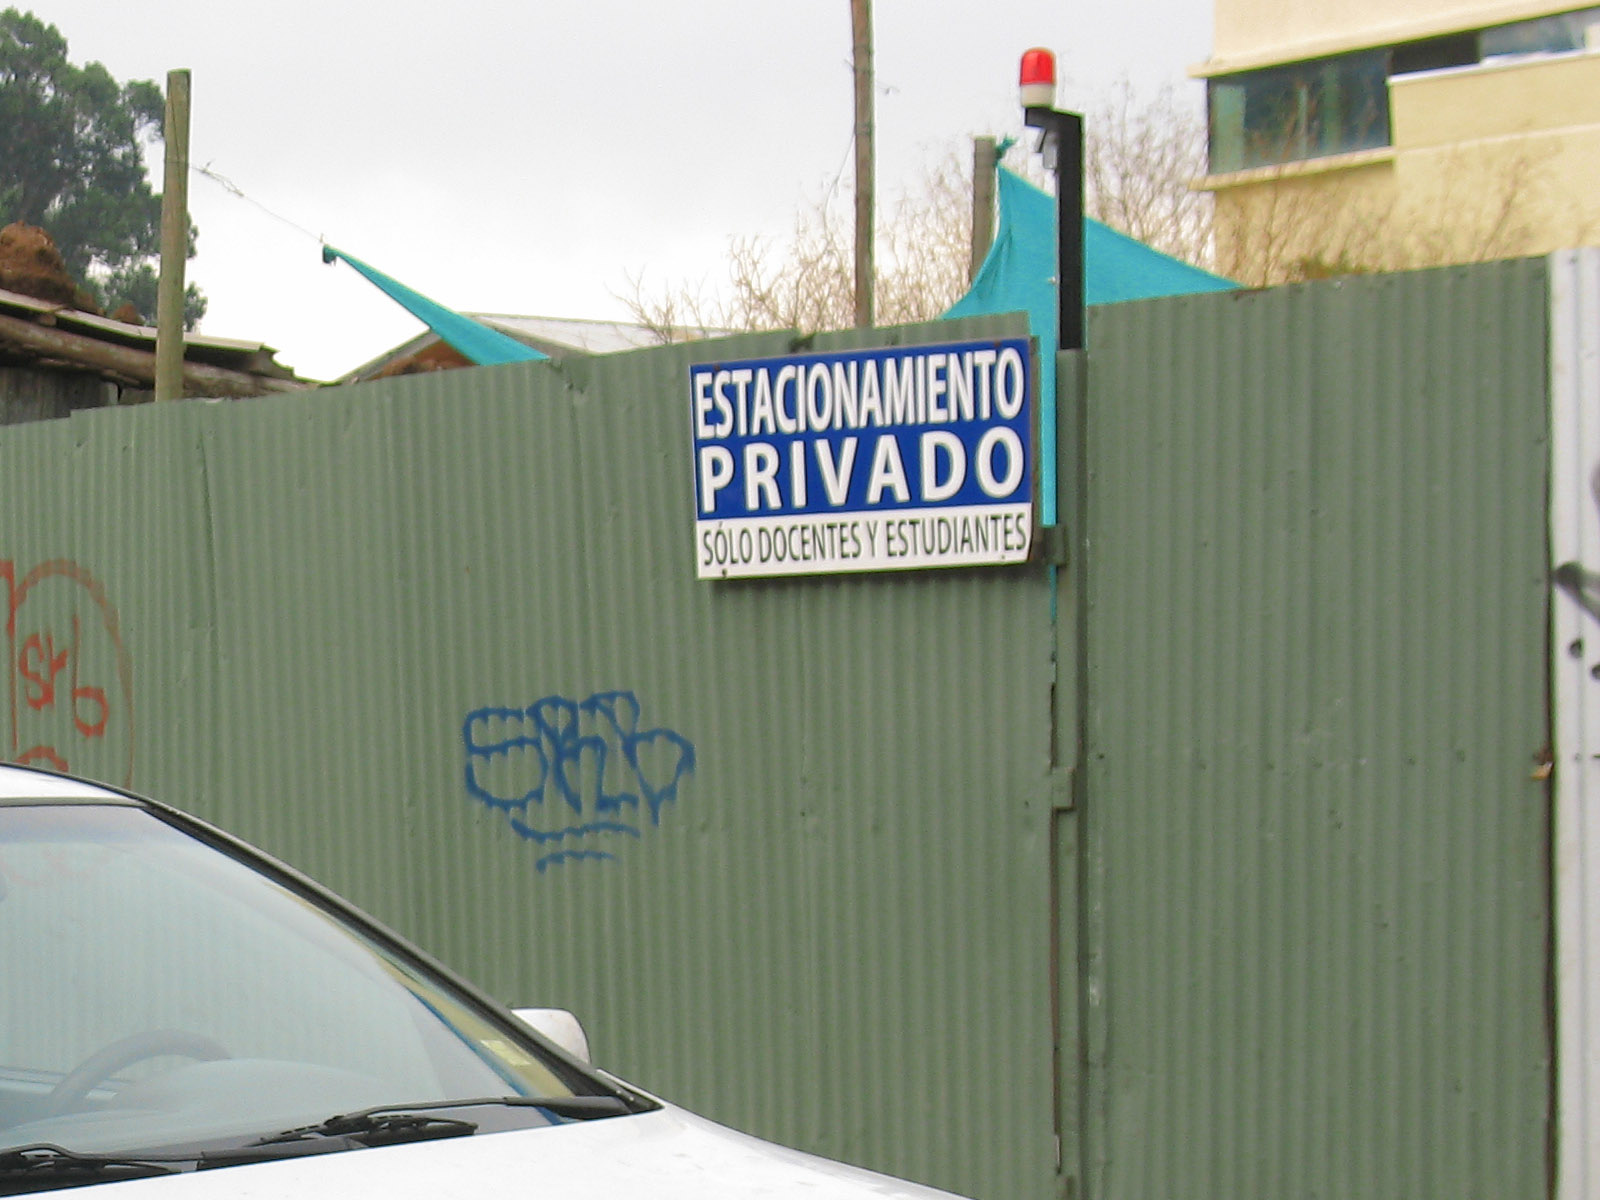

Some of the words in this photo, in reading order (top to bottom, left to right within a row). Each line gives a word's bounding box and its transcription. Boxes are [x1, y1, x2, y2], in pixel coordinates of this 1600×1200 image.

[695, 347, 1025, 439] ESTACIONAMIENTO
[700, 426, 1025, 513] PRIVADO
[703, 520, 753, 566] SÓLO
[758, 519, 862, 564] DOCENTES
[866, 519, 880, 558] Y
[886, 511, 1027, 557] ESTUDIANTES
